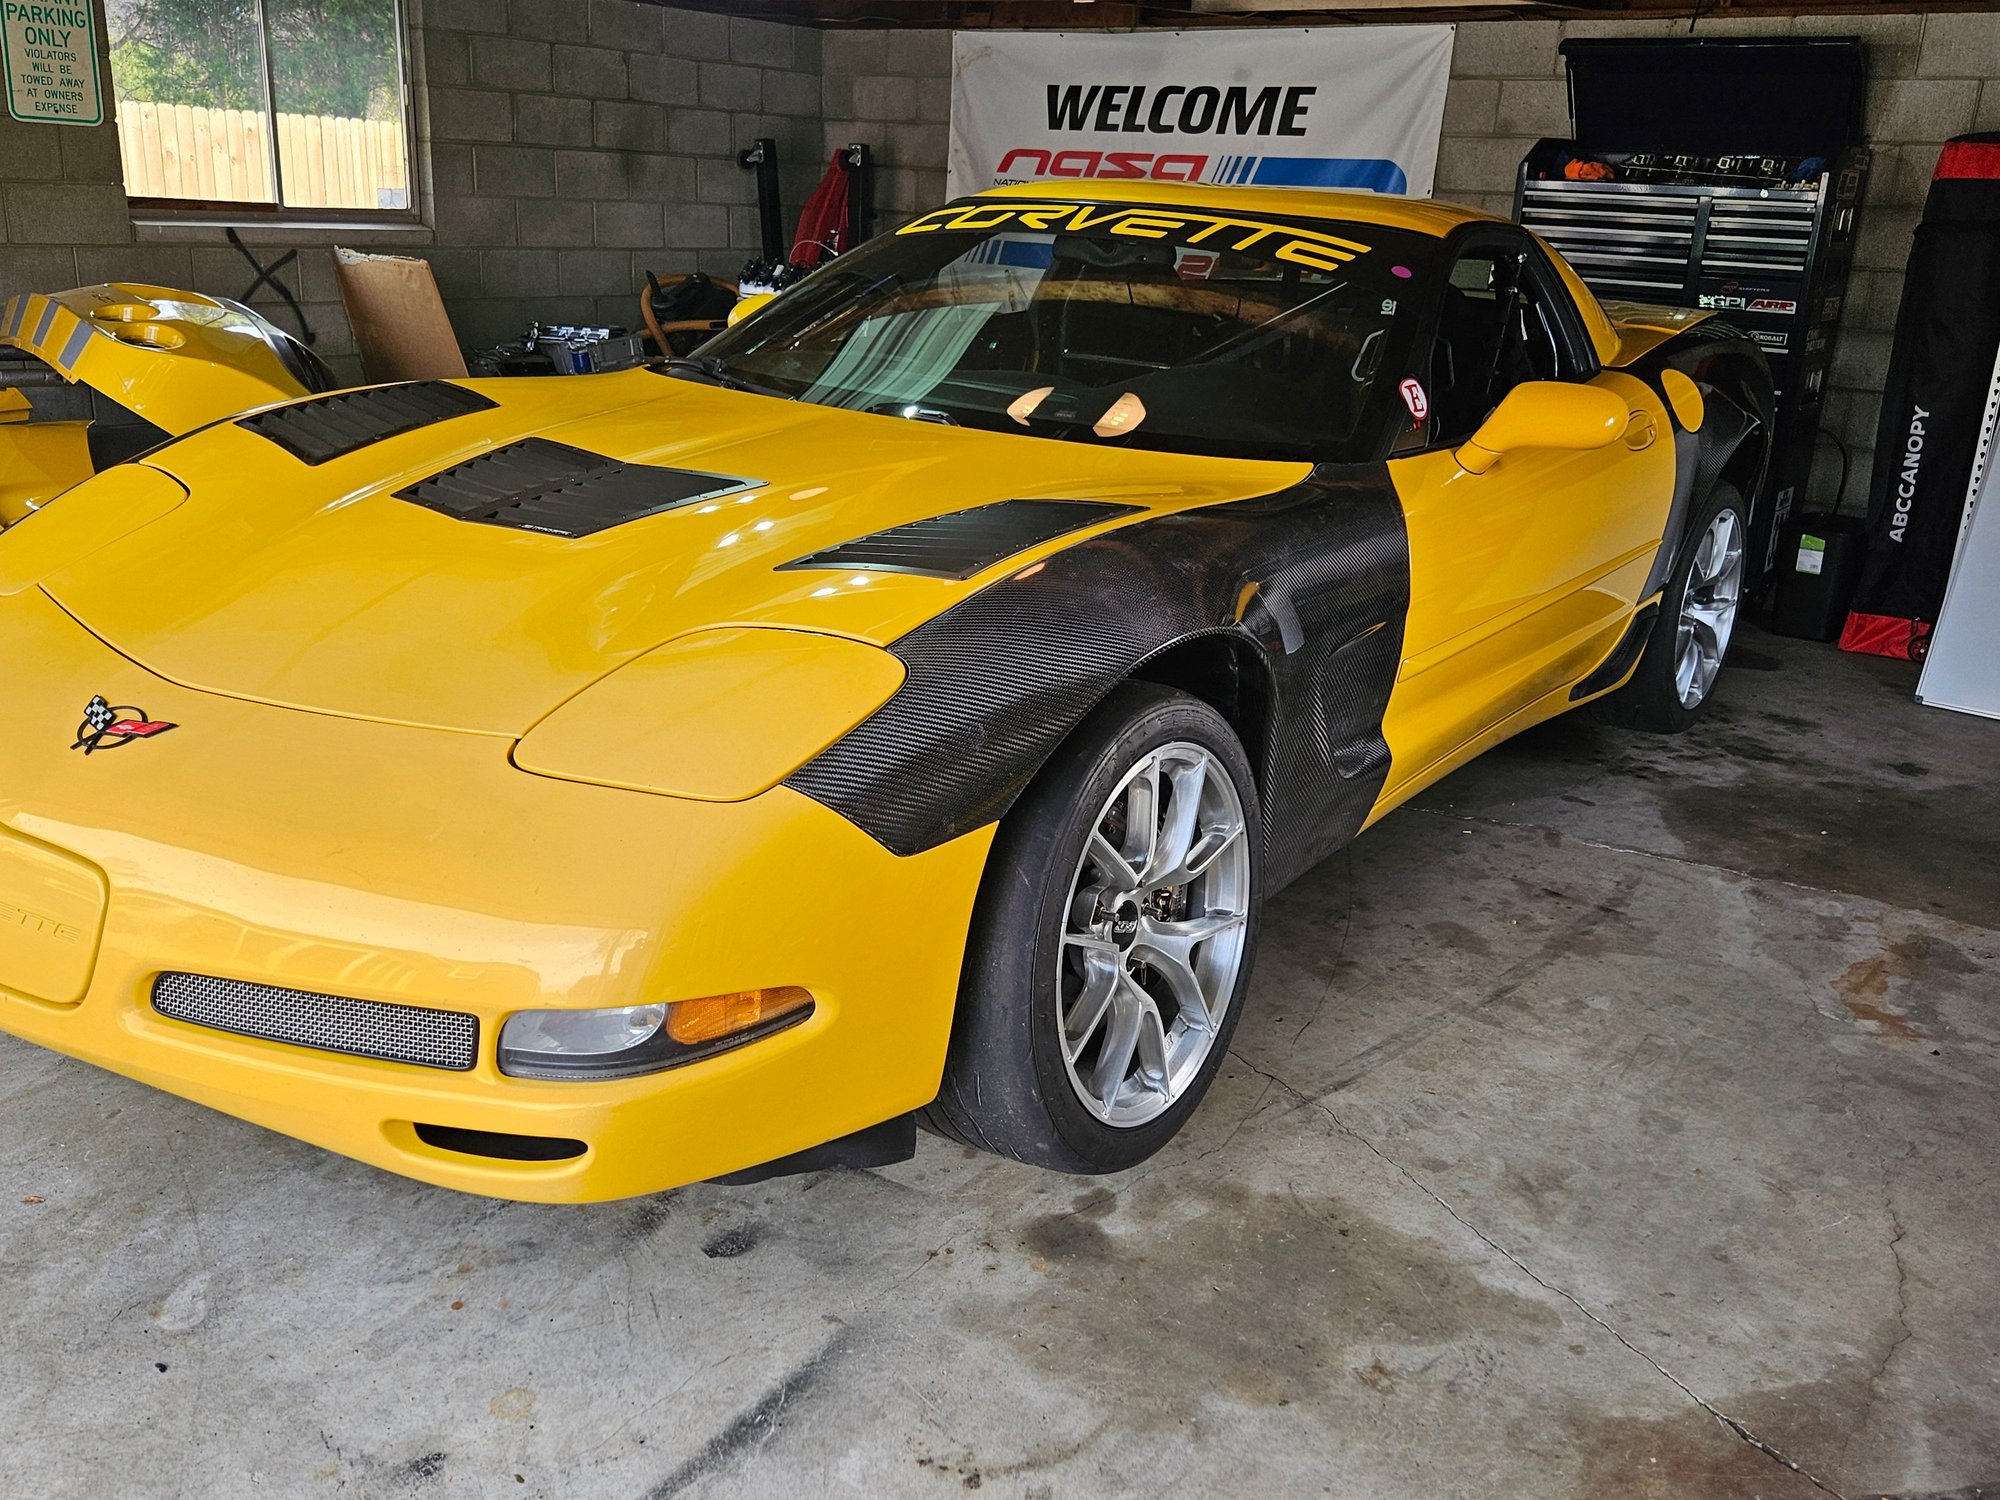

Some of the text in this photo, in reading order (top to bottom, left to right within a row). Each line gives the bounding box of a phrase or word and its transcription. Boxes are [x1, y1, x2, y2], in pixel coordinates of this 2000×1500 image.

[5, 2, 86, 28] PARKING
[24, 26, 71, 48] ONLY
[24, 48, 77, 62] VIOLATORS
[32, 62, 72, 74] WILL BE
[21, 74, 85, 88] TOWED AWAY
[27, 88, 84, 101] AT OWNERS
[34, 101, 78, 114] EXPENSE
[1046, 84, 1318, 136] WELCOME
[895, 203, 1372, 271] CORVETTE
[1751, 300, 1794, 310] ARP
[1759, 334, 1783, 342] KOBALT
[1404, 383, 1425, 413] E
[1889, 404, 1930, 543] ABCCANOPY
